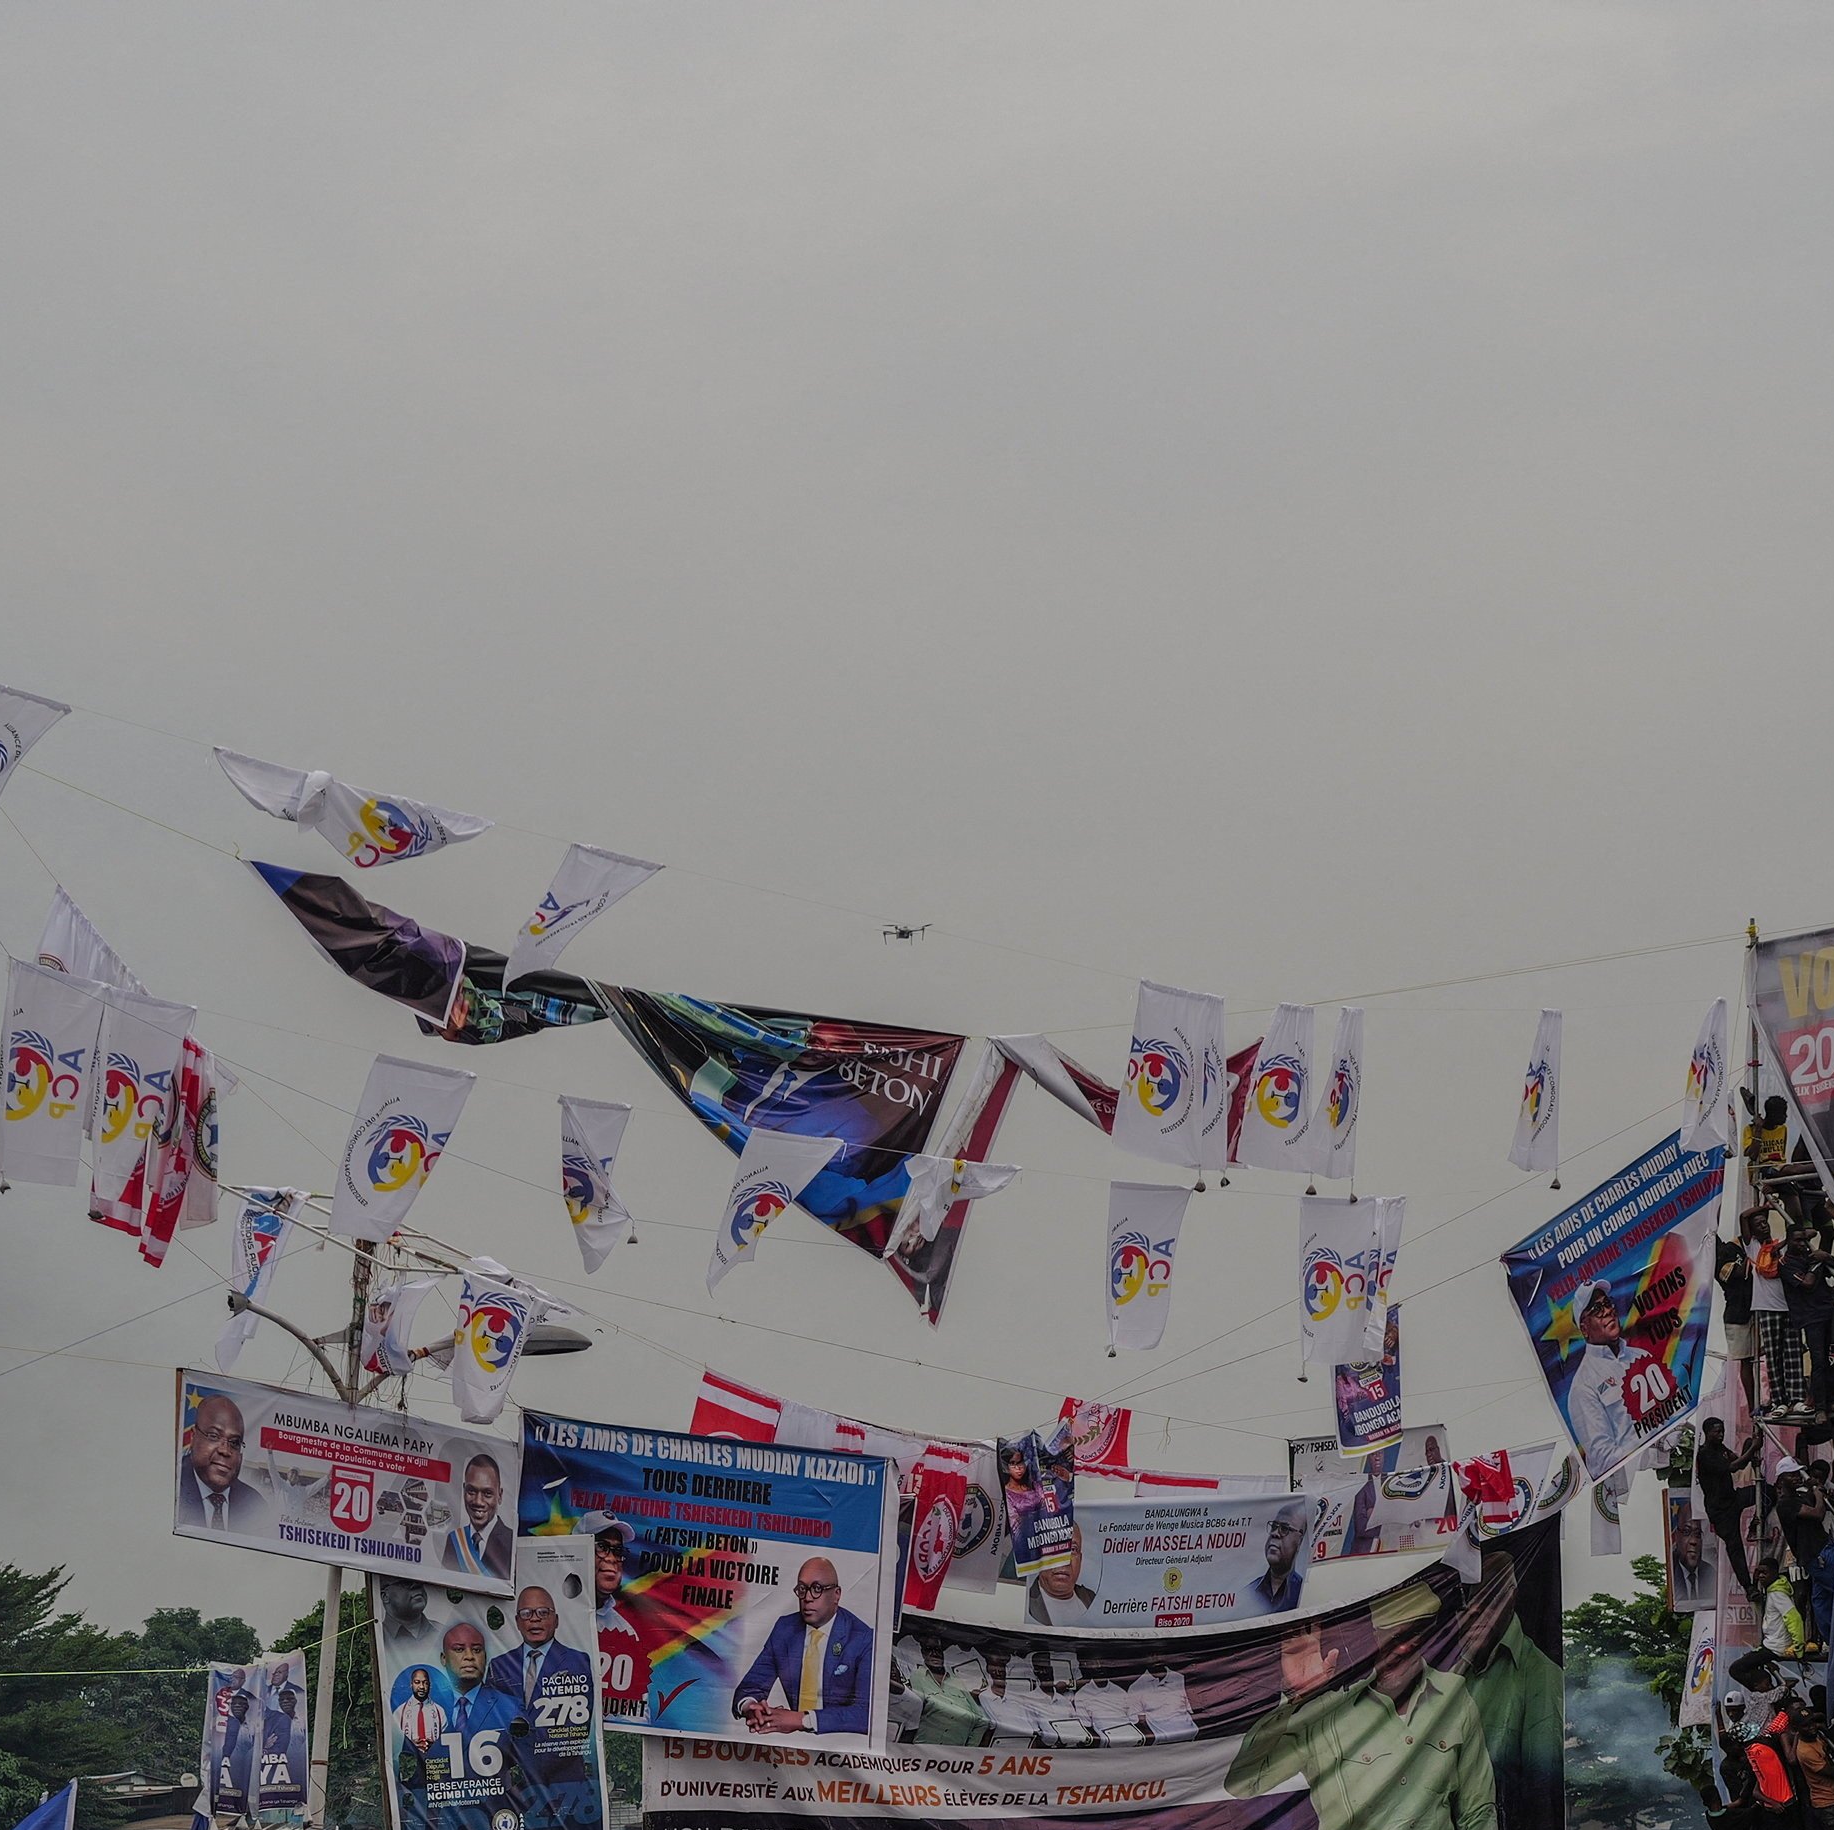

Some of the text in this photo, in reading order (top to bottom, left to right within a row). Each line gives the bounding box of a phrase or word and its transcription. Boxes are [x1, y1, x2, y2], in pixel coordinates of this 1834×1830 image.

[1634, 1266, 1687, 1318] VOTONS
[1629, 1363, 1671, 1415] 20
[1633, 1384, 1693, 1440] PRESIDENT
[274, 1413, 434, 1454] MBUMBA NGALIEMA PAPY
[547, 1422, 865, 1486] LES AMIS DE CHARLES MUDIAY KAZADI
[333, 1482, 371, 1523] 20
[643, 1467, 773, 1506] TOUS DERRIERE
[279, 1524, 422, 1563] TSHISEKEDI TSHILOMBO
[655, 1526, 749, 1555] FATSHI BETON
[1103, 1532, 1247, 1553] Didier MASSELA NDUDI
[639, 1550, 780, 1586] POUR LA VICTOIRE
[682, 1585, 734, 1610] FINALE
[1103, 1593, 1235, 1614] Derrière FATSHI BETON
[542, 1674, 587, 1687] PACIANO
[542, 1684, 589, 1696] NYEMBO
[533, 1695, 589, 1727] 278
[441, 1729, 503, 1779] 16
[815, 1752, 1054, 1776] ACADÉMIQUES POUR 5 ANS
[427, 1778, 501, 1792] PERSEVERANCE
[427, 1786, 505, 1801] NGIMBI VANGU
[661, 1780, 1167, 1807] D'UNIVERSITÉ AUX MEILLEURS ÉLÈVES DE LA TSHANGU.
